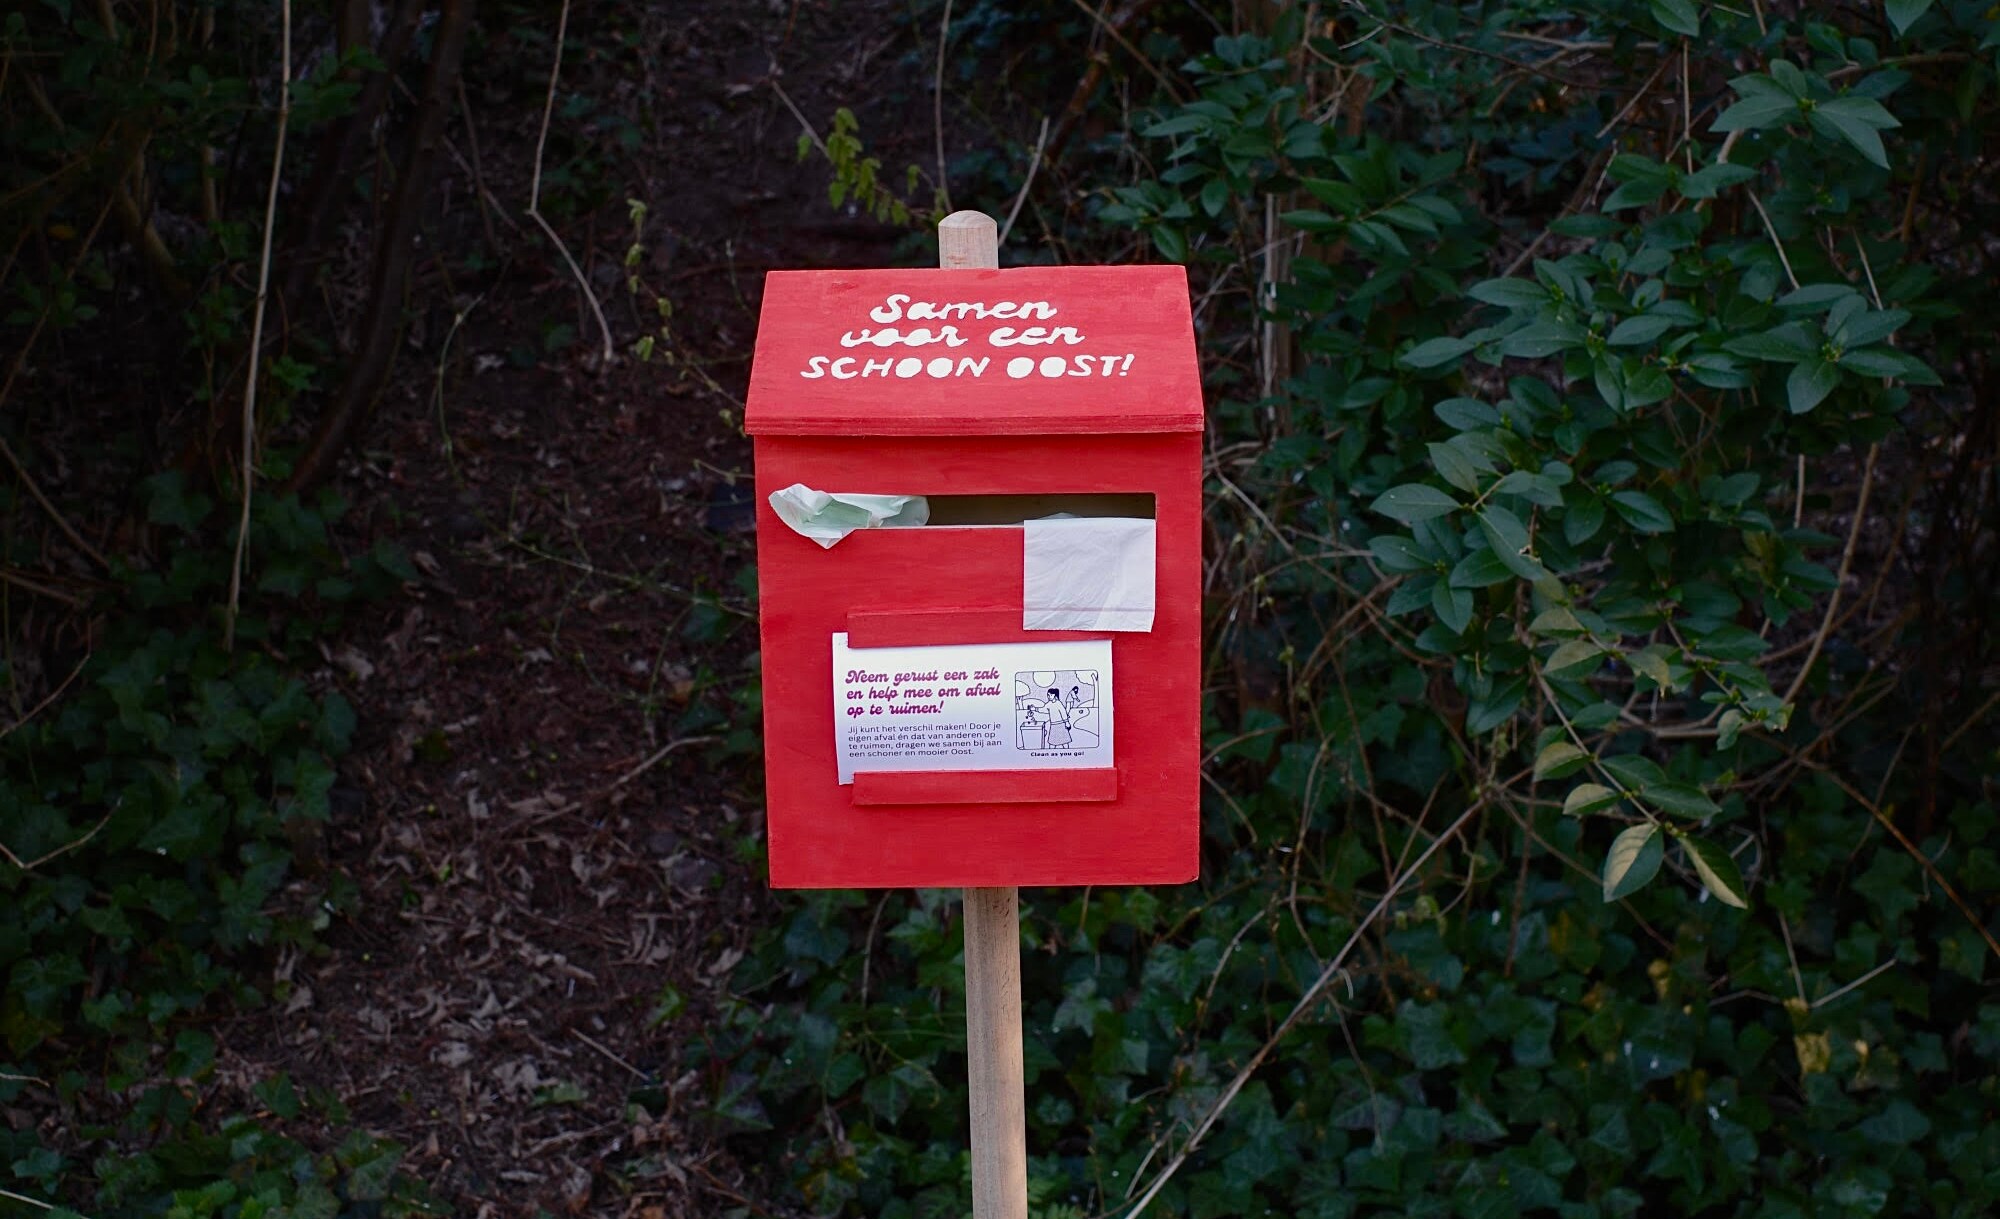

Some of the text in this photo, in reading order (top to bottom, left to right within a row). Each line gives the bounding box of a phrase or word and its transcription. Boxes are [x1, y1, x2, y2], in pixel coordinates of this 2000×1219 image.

[869, 293, 1058, 324] Samen
[839, 325, 1086, 348] voor een
[800, 353, 1136, 379] SCHOON OOST!
[845, 667, 999, 686] Neem gerust een zak
[846, 683, 1001, 701] en help mee om afval
[847, 701, 944, 718] op te ruimen!
[848, 725, 858, 734] Jij
[860, 724, 880, 732] kunt
[882, 724, 896, 732] het
[898, 723, 933, 732] verschil
[935, 723, 967, 731] maken!
[993, 722, 1001, 731] je
[848, 735, 872, 743] eigen
[874, 732, 895, 741] afval
[898, 732, 908, 740] én
[910, 732, 925, 740] dat
[984, 732, 996, 740] op
[849, 742, 858, 750] te
[860, 741, 893, 750] ruimen,
[895, 741, 925, 750] dragen
[973, 739, 985, 749] bij
[867, 749, 902, 757] schoner
[918, 748, 949, 756] mooier
